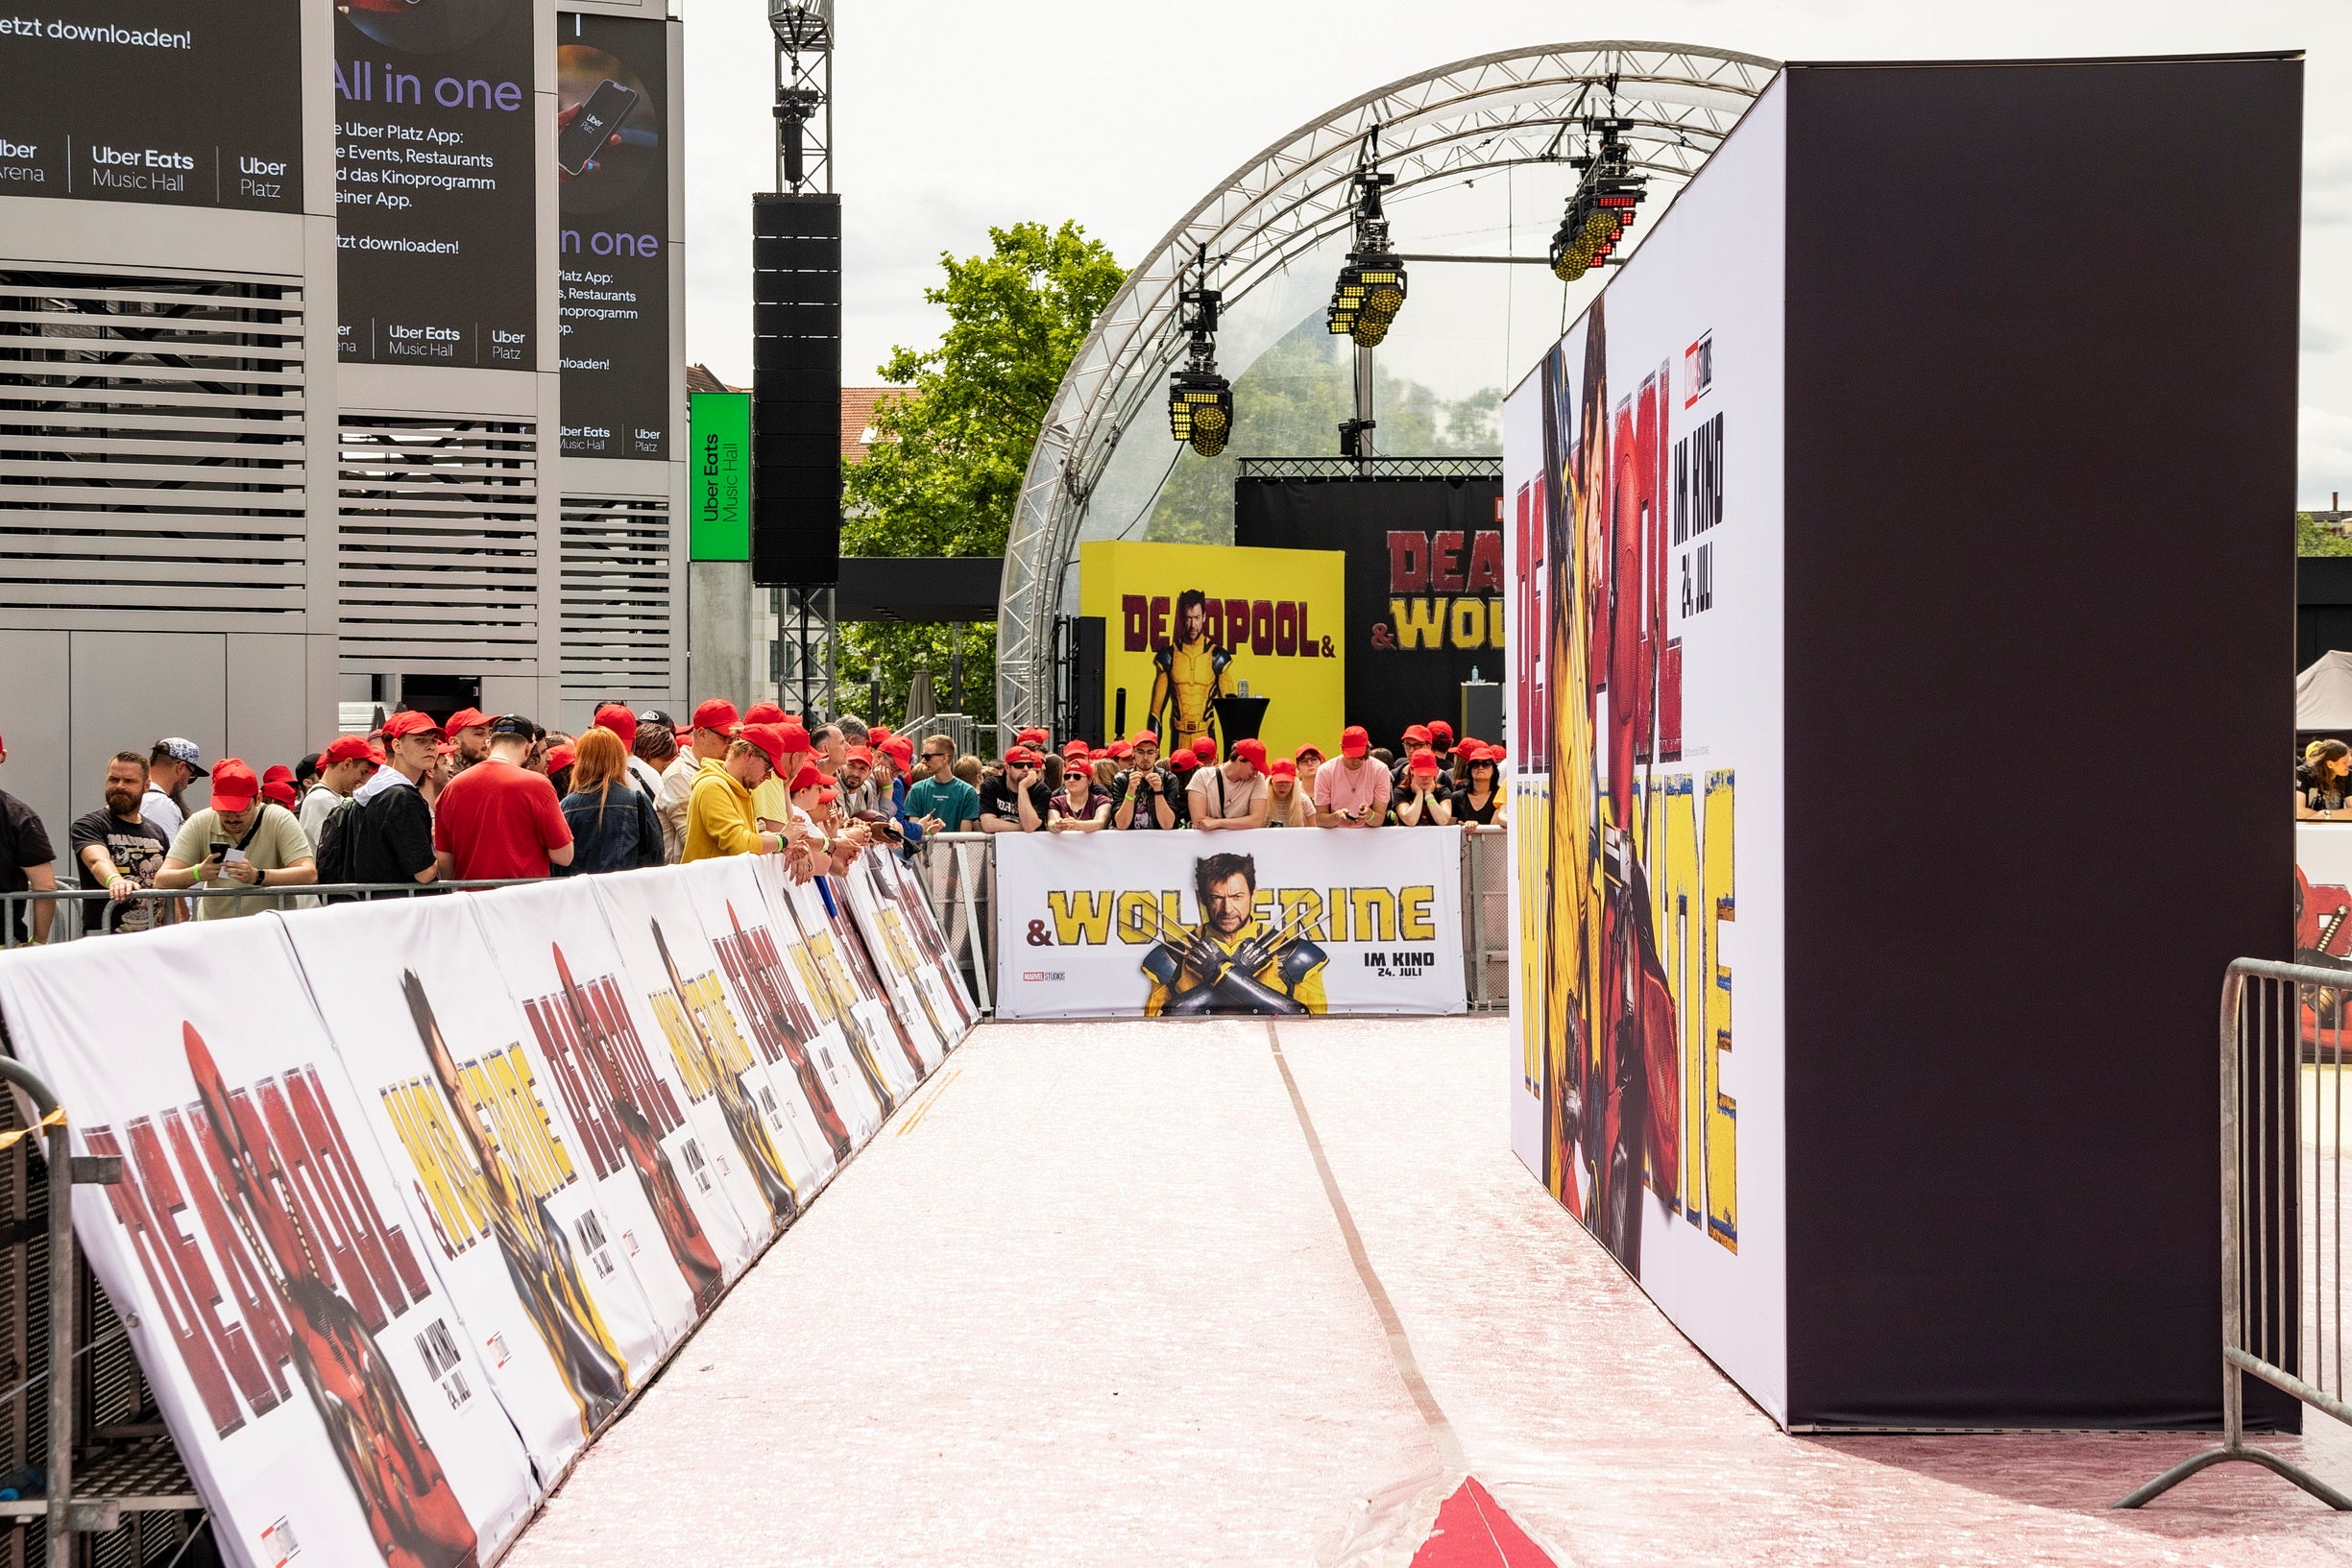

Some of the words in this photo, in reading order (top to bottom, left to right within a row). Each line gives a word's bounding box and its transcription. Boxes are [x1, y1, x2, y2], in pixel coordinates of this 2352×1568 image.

[0, 17, 42, 37] etzt
[47, 20, 191, 50] downloaden!
[385, 63, 421, 105] in
[434, 77, 522, 111] one
[346, 122, 384, 138] Uber
[387, 125, 424, 141] Platz
[426, 128, 464, 146] App:
[0, 139, 37, 158] ber
[92, 146, 141, 166] Uber
[145, 149, 194, 170] Eats
[349, 145, 403, 164] Events,
[406, 149, 494, 168] Restaurants
[240, 157, 286, 177] Uber
[92, 168, 147, 190] Music
[152, 173, 183, 192] Hall
[240, 179, 281, 198] Platz
[351, 168, 378, 182] das
[382, 169, 496, 191] Kinoprogramm
[376, 191, 412, 210] App.
[359, 235, 459, 255] downloaden!
[591, 231, 659, 258] one
[584, 271, 614, 286] App:
[569, 288, 637, 302] Restaurants
[389, 325, 424, 339] Uber
[425, 326, 460, 341] Eats
[492, 329, 525, 345] Uber
[389, 341, 427, 356] Music
[430, 343, 453, 357] Hall
[492, 345, 521, 360] Platz
[583, 426, 611, 438] Eats
[635, 428, 661, 440] Uber
[587, 440, 605, 450] Hall
[635, 441, 658, 452] Platz
[704, 433, 718, 476] Eats
[722, 442, 738, 471] Hall
[1674, 436, 1688, 547] IM
[1692, 410, 1724, 538] KINO
[704, 481, 718, 522] Uber
[722, 474, 738, 522] Music
[1026, 919, 1053, 947] &
[1048, 884, 1436, 947] WOLERINE
[1365, 952, 1387, 967] IM
[1393, 952, 1435, 967] KINO
[1378, 967, 1395, 977] 24.
[1399, 967, 1422, 977] JULI
[378, 1040, 579, 1254] WOLERINE
